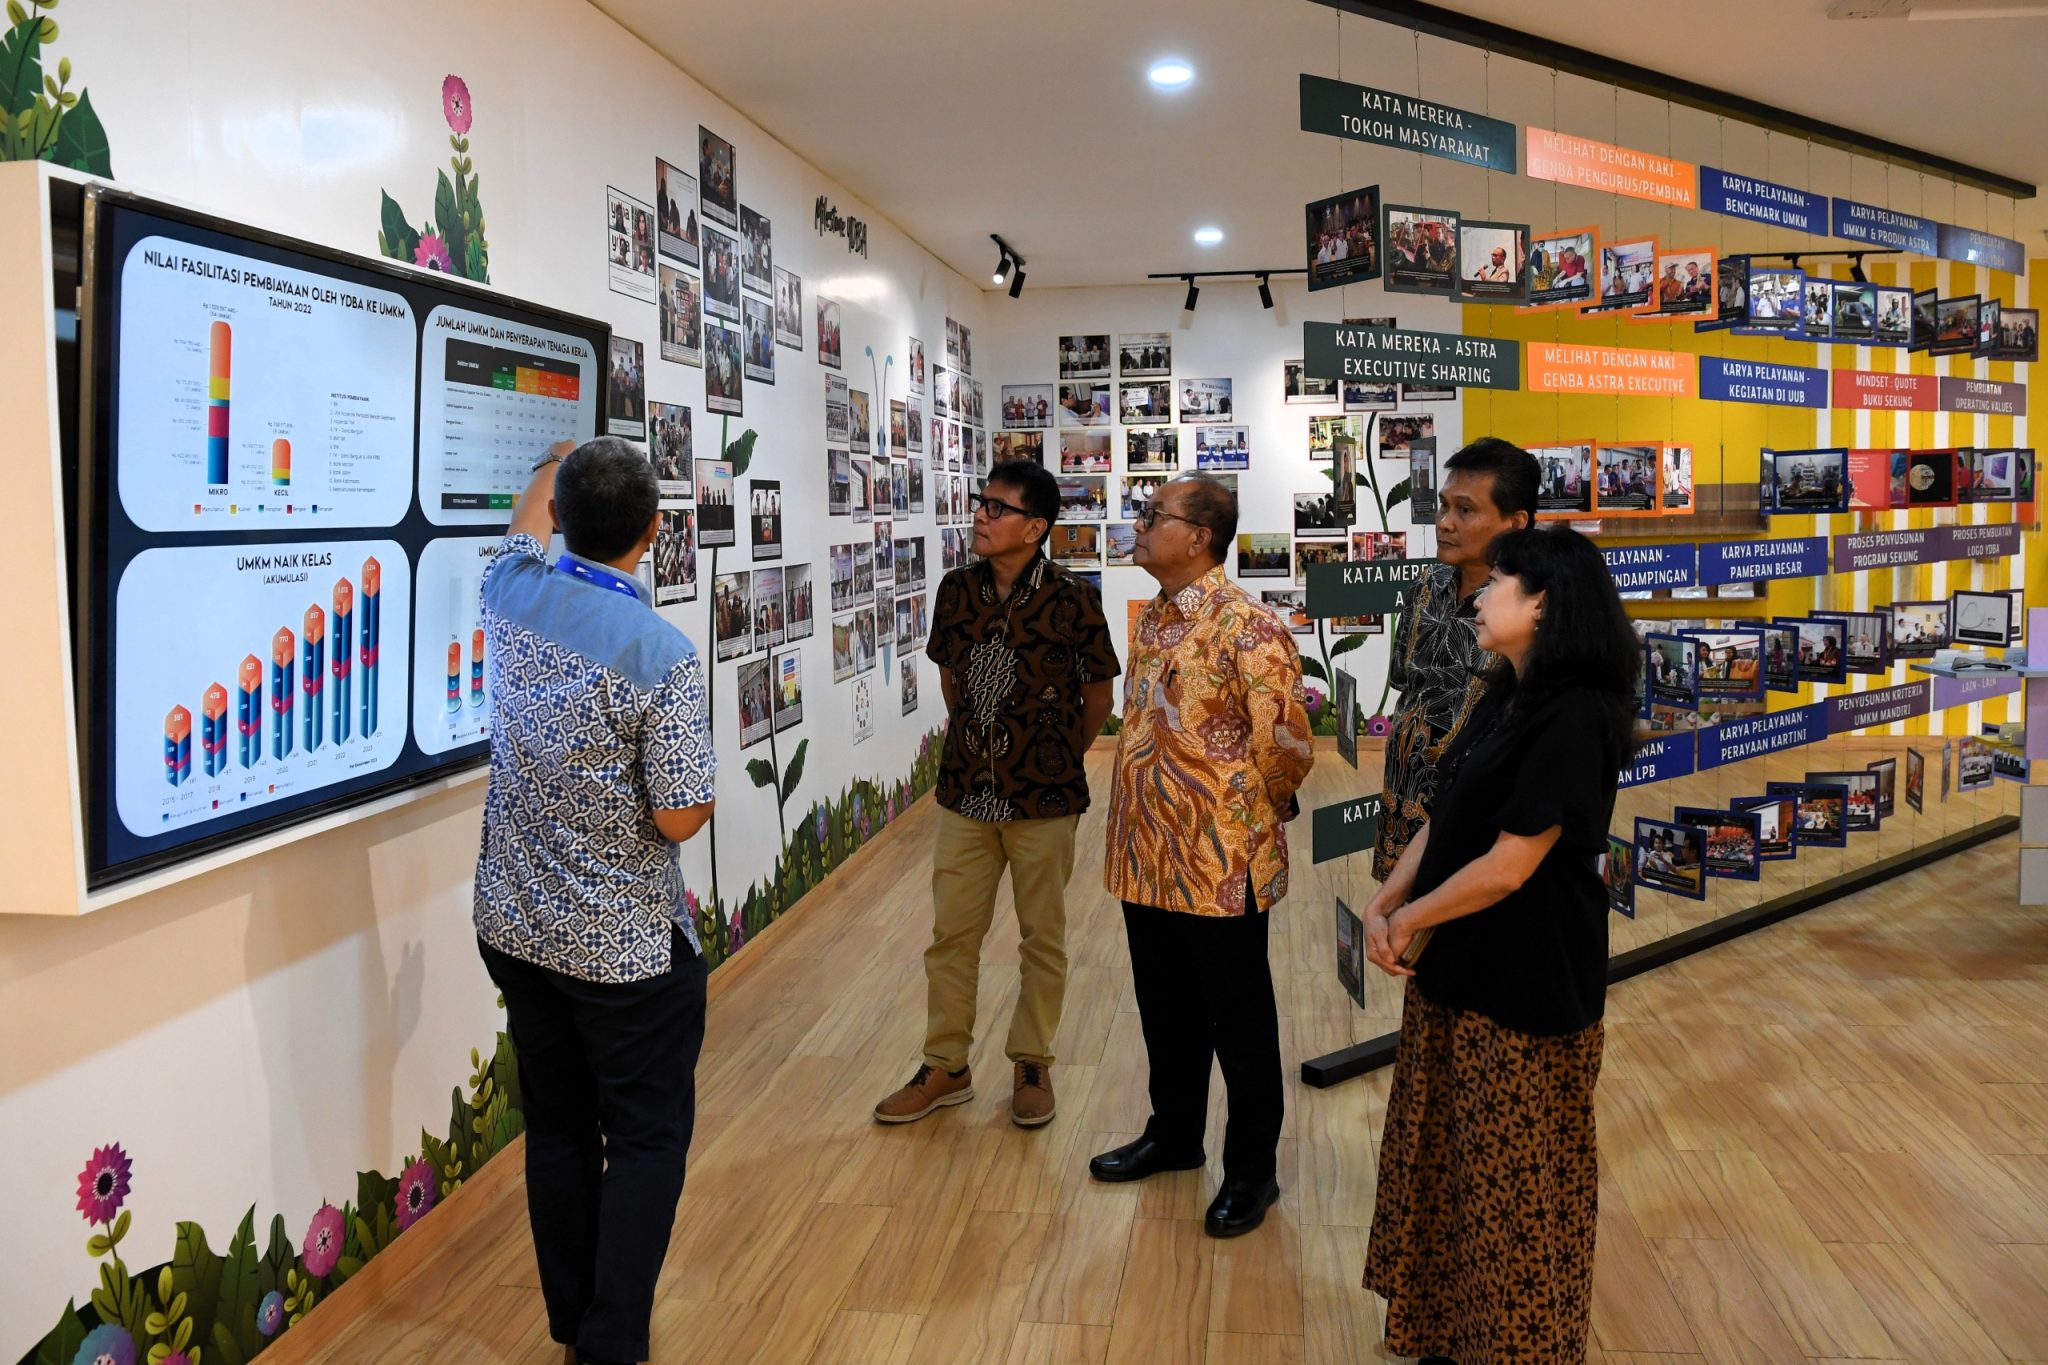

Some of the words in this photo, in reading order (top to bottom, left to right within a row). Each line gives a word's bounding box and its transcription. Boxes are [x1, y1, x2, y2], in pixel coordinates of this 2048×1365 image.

[1362, 91, 1402, 115] KATA
[1407, 101, 1463, 130] MEREKA
[1341, 114, 1393, 140] TOKOH
[1399, 126, 1490, 162] MASYARAKAT
[1543, 135, 1596, 160] MELIHAT
[1600, 148, 1645, 170] DENGAN
[1649, 160, 1674, 177] KAKI
[1533, 158, 1573, 179] GENBA
[1578, 166, 1690, 203] PENGURUS/PEMBINA
[1722, 175, 1752, 195] KARYA
[1754, 183, 1805, 208] PELAYANAN
[1726, 197, 1780, 222] BENCHMARK
[1782, 211, 1808, 229] UMKM
[1850, 205, 1875, 221] KARYA
[1877, 212, 1918, 231] PELAYANAN
[1843, 223, 1866, 238] UMKM
[1870, 229, 1877, 239] &
[1878, 230, 1906, 246] PRODUK
[1908, 236, 1930, 251] ASTRA
[144, 250, 178, 271] NILAI
[181, 258, 240, 284] FASILITASI
[244, 274, 309, 298] PEMBIAYAAN
[312, 287, 337, 304] OLEH
[340, 293, 364, 311] YDBA
[366, 299, 378, 313] KE
[380, 302, 405, 319] UMKM
[269, 296, 292, 311] TAHUN
[294, 301, 312, 315] 2022
[436, 316, 466, 332] JUMLAH
[467, 322, 489, 337] UMKM
[490, 327, 504, 340] DAN
[506, 330, 546, 349] PENYERAPAN
[547, 340, 570, 354] TENAGA
[571, 346, 588, 358] KERJA
[1335, 329, 1377, 349] KATA
[1382, 333, 1441, 354] MEREKA
[1455, 340, 1497, 359] ASTRA
[1545, 348, 1598, 365] MELIHAT
[1602, 351, 1647, 368] DENGAN
[1651, 355, 1676, 369] KAKI
[1344, 358, 1426, 379] EXECUTIVE
[1431, 363, 1491, 384] SHARING
[1723, 362, 1753, 378] KARYA
[1755, 366, 1805, 383] PELAYANAN
[1543, 372, 1583, 387] GENBA
[1588, 375, 1624, 390] ASTRA
[1628, 376, 1685, 392] EXECUTIVE
[1856, 375, 1888, 388] MINDSET
[1894, 377, 1918, 391] QUOTE
[1966, 381, 2002, 395] PEMBUATAN
[1729, 384, 1774, 402] KEGIATAN
[1776, 389, 1786, 402] DI
[1788, 390, 1805, 404] UUB
[1863, 394, 1883, 407] BUKU
[1884, 395, 1913, 409] SEKUNG
[1955, 398, 1989, 410] OPERATING
[1991, 401, 2013, 413] VALUES
[208, 488, 228, 496] MIKRO
[274, 489, 289, 497] KECIL
[1847, 535, 1875, 550] PROSES
[1876, 532, 1925, 547] PENYUSUNAN
[1952, 528, 1978, 541] PROSES
[1979, 526, 2012, 539] PEMBUATAN
[1601, 549, 1663, 566] ELAYANAN
[1722, 545, 1752, 560] KARYA
[1754, 542, 1804, 557] PELAYANAN
[1853, 554, 1888, 567] PROGRAM
[1889, 550, 1919, 564] SEKUNG
[1967, 544, 1984, 557] LOGO
[237, 556, 271, 571] UMKM
[274, 554, 298, 570] NAIK
[301, 552, 332, 567] KELAS
[1730, 564, 1773, 580] PAMERAN
[1775, 561, 1802, 576] BESAR
[263, 572, 309, 585] (AKUMULASI)
[1343, 566, 1384, 584] KATA
[1838, 692, 1891, 711] PENYUSUNAN
[1892, 684, 1924, 702] KRITERIA
[1854, 713, 1879, 726] UMKM
[1880, 704, 1911, 721] MANDIRI
[1719, 724, 1750, 743] KARYA
[1752, 713, 1803, 736] PELAYANAN
[1721, 740, 1769, 761] PERAYAAN
[1771, 729, 1807, 749] KARTINI
[1636, 764, 1656, 781] LPB
[1343, 800, 1381, 824] KATA
